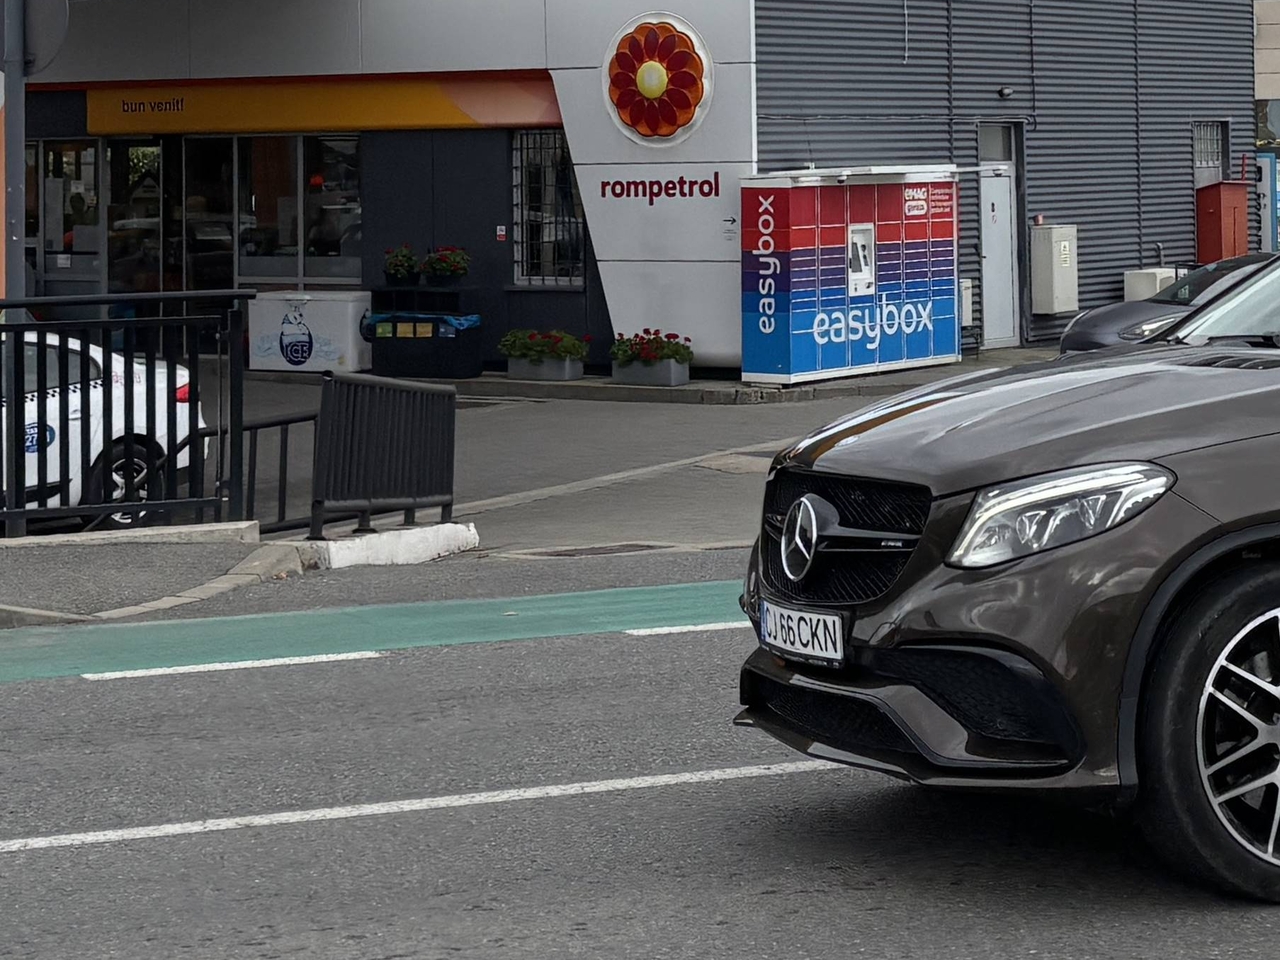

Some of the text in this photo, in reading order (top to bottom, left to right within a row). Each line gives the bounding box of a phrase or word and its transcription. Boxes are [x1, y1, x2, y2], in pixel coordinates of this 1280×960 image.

[121, 97, 184, 113] bun venit!
[600, 171, 721, 206] rompetrol
[752, 194, 781, 335] easybox
[813, 293, 934, 350] easybox
[780, 612, 796, 647] 66
[797, 615, 838, 654] CKN
